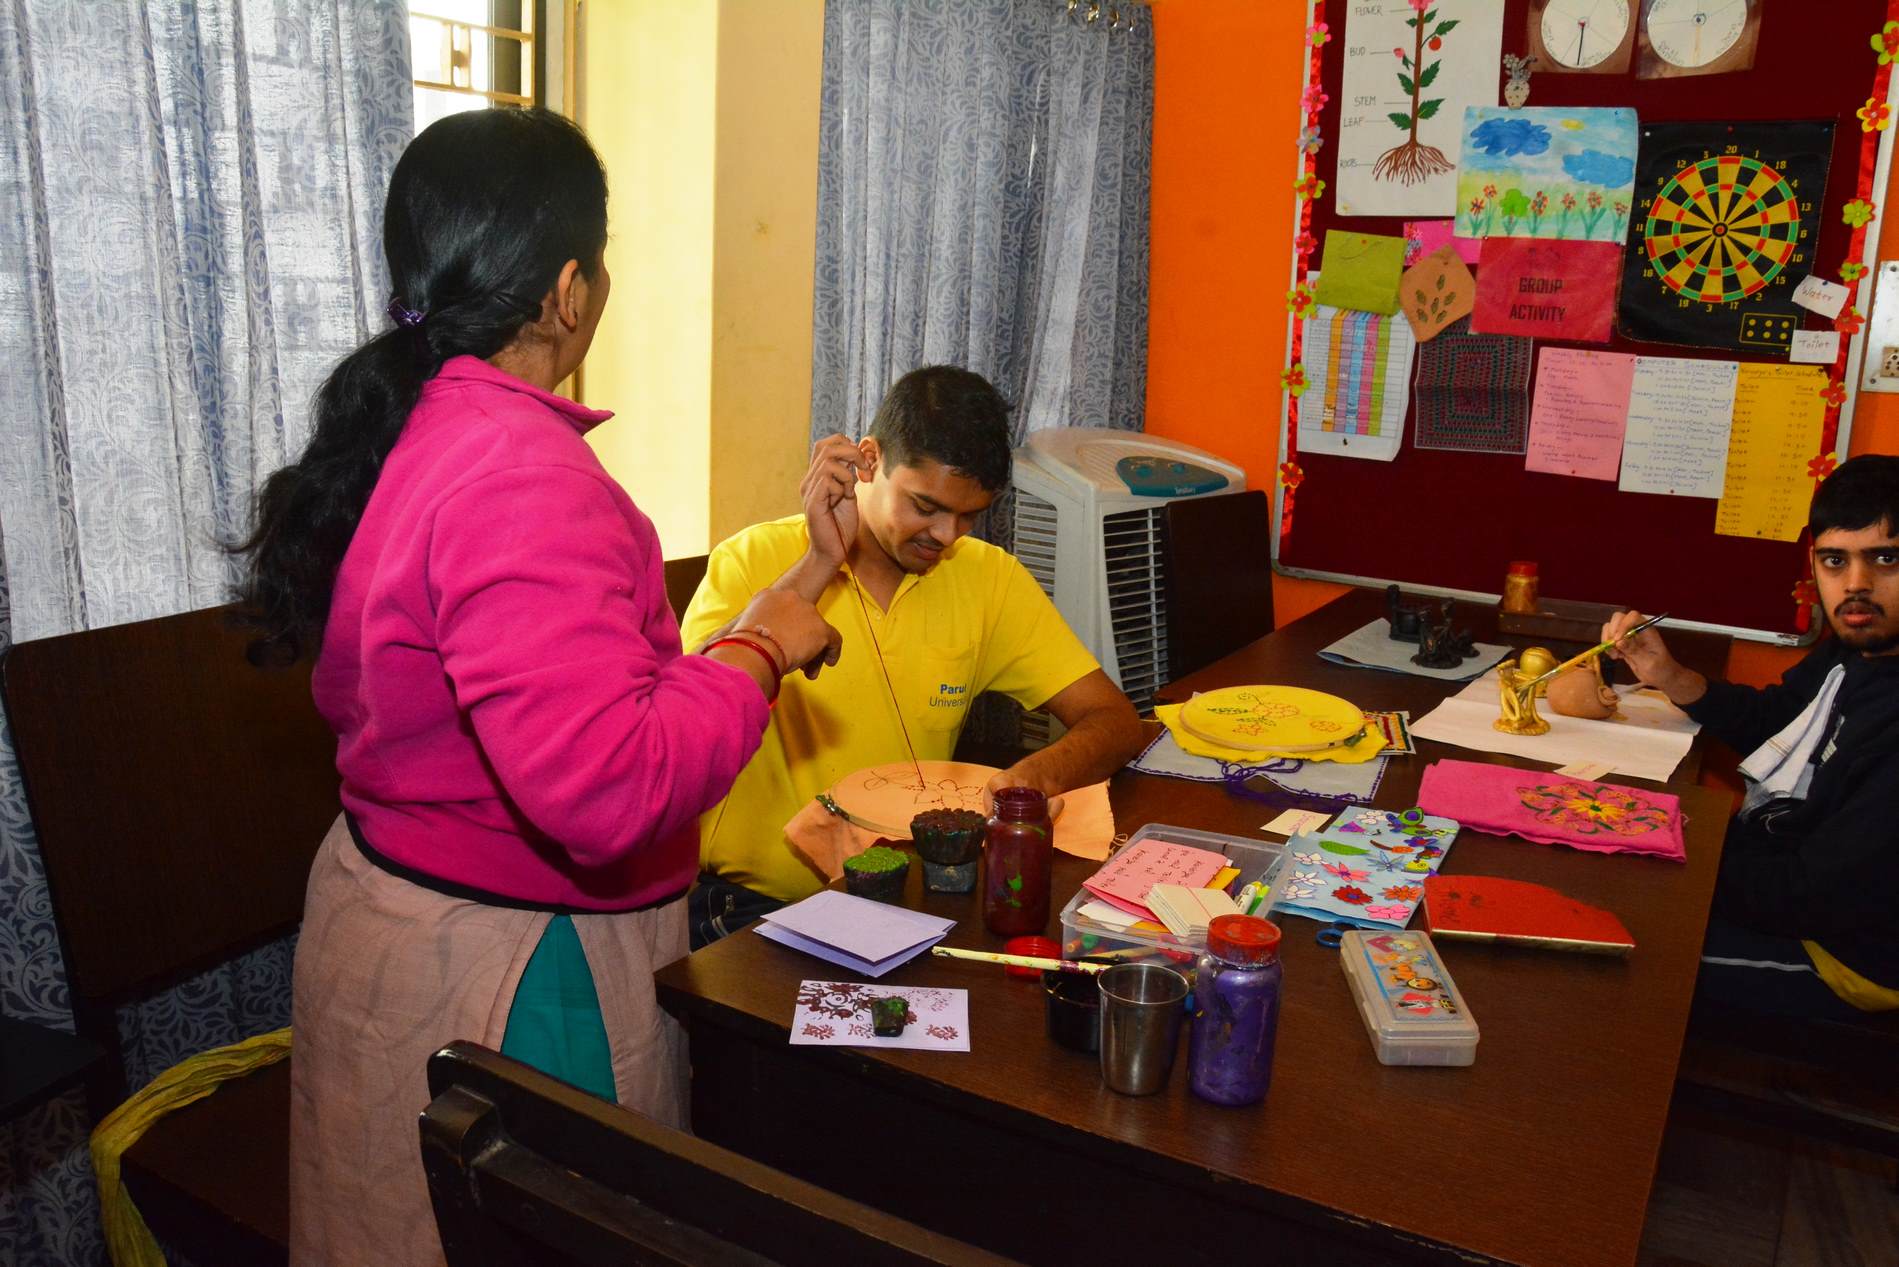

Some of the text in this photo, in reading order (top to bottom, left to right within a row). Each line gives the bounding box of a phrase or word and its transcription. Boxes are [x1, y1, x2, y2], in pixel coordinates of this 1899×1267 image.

[1350, 46, 1366, 57] BUD
[1354, 95, 1376, 107] STEM
[1343, 116, 1365, 128] LEAF
[1725, 145, 1738, 154] 20
[1703, 150, 1709, 159] 5
[1677, 160, 1687, 168] 12
[1775, 160, 1787, 170] 18
[1791, 179, 1799, 188] 4
[1801, 202, 1812, 211] 13
[1636, 223, 1644, 232] 11
[1800, 230, 1808, 238] 6
[1792, 253, 1803, 262] 10
[1519, 277, 1563, 294] GROUP
[1801, 284, 1833, 301] Water
[1729, 301, 1740, 310] 17
[1509, 303, 1566, 322] ACTIVITY
[1798, 339, 1830, 349] Toilet
[940, 684, 967, 694] Parul
